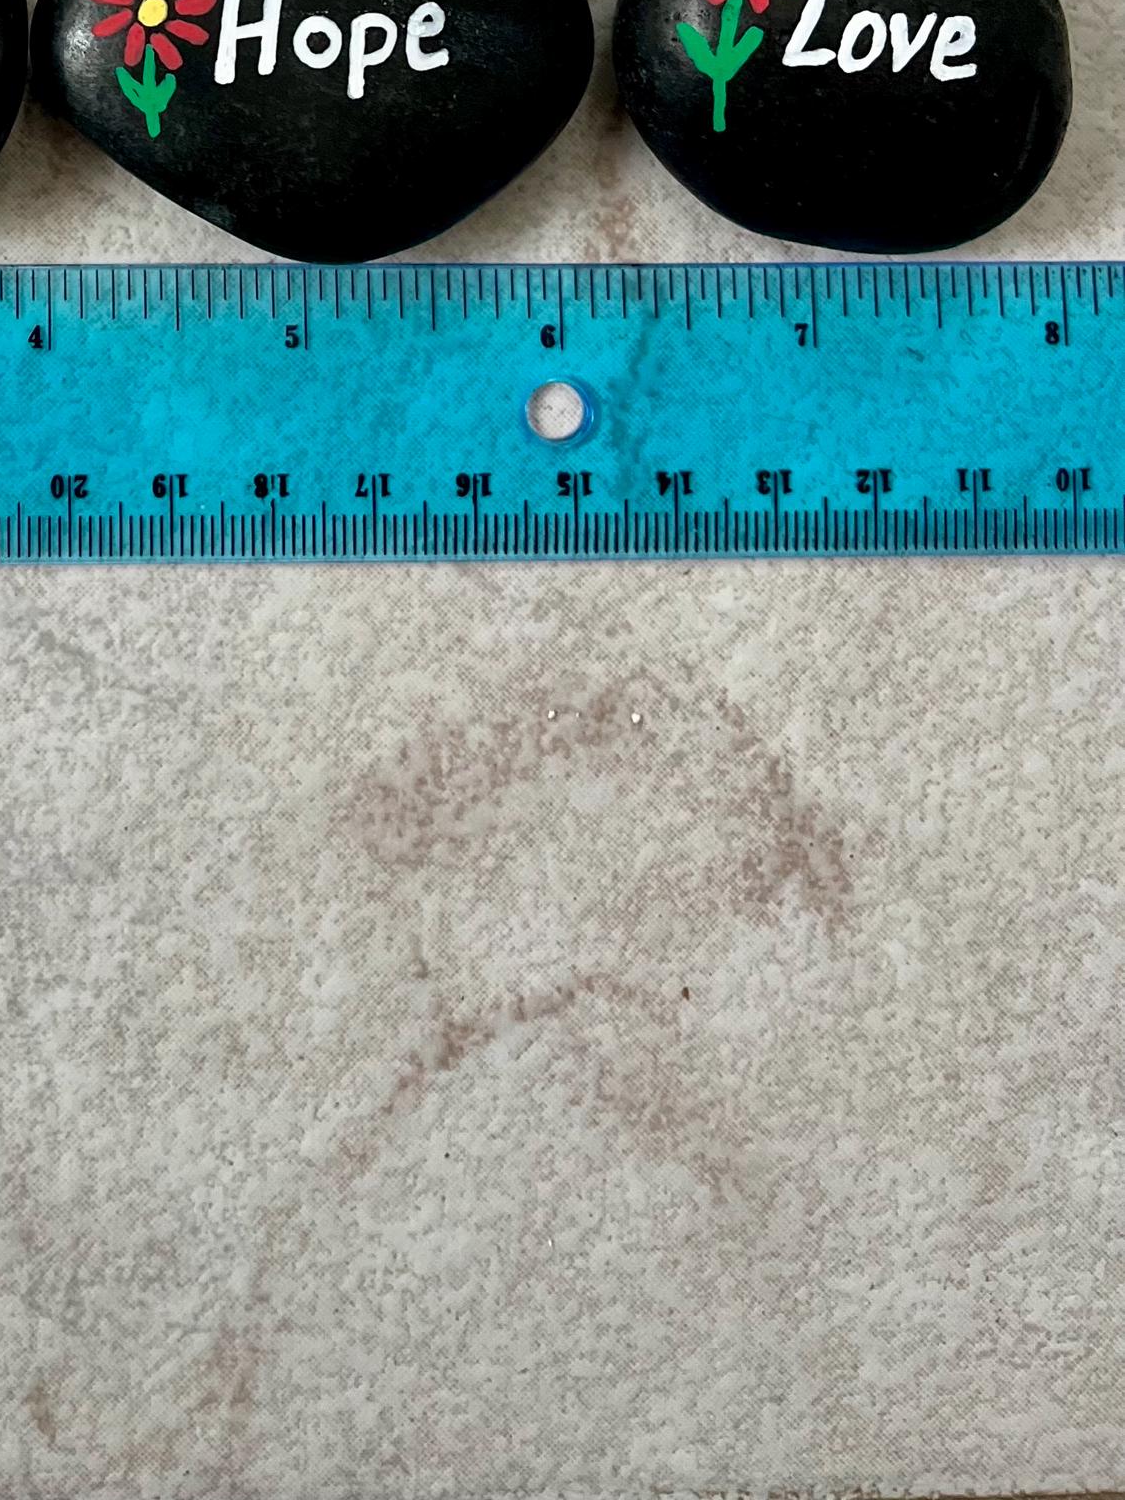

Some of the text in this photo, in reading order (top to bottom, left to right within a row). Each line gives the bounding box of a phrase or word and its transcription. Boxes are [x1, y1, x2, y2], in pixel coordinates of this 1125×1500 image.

[27, 324, 44, 350] 4
[284, 324, 301, 350] 5
[540, 324, 557, 349] 6
[794, 322, 809, 347] 7
[1045, 321, 1061, 346] 8
[50, 474, 89, 500] 20
[152, 473, 188, 499] 19
[253, 473, 290, 501] 18
[354, 472, 391, 499] 17
[455, 472, 492, 498] 16
[556, 471, 593, 497] 15
[655, 470, 694, 497] 14
[756, 469, 793, 496] 13
[855, 468, 892, 495] 12
[956, 468, 992, 493] 11
[1055, 467, 1092, 493] 10
